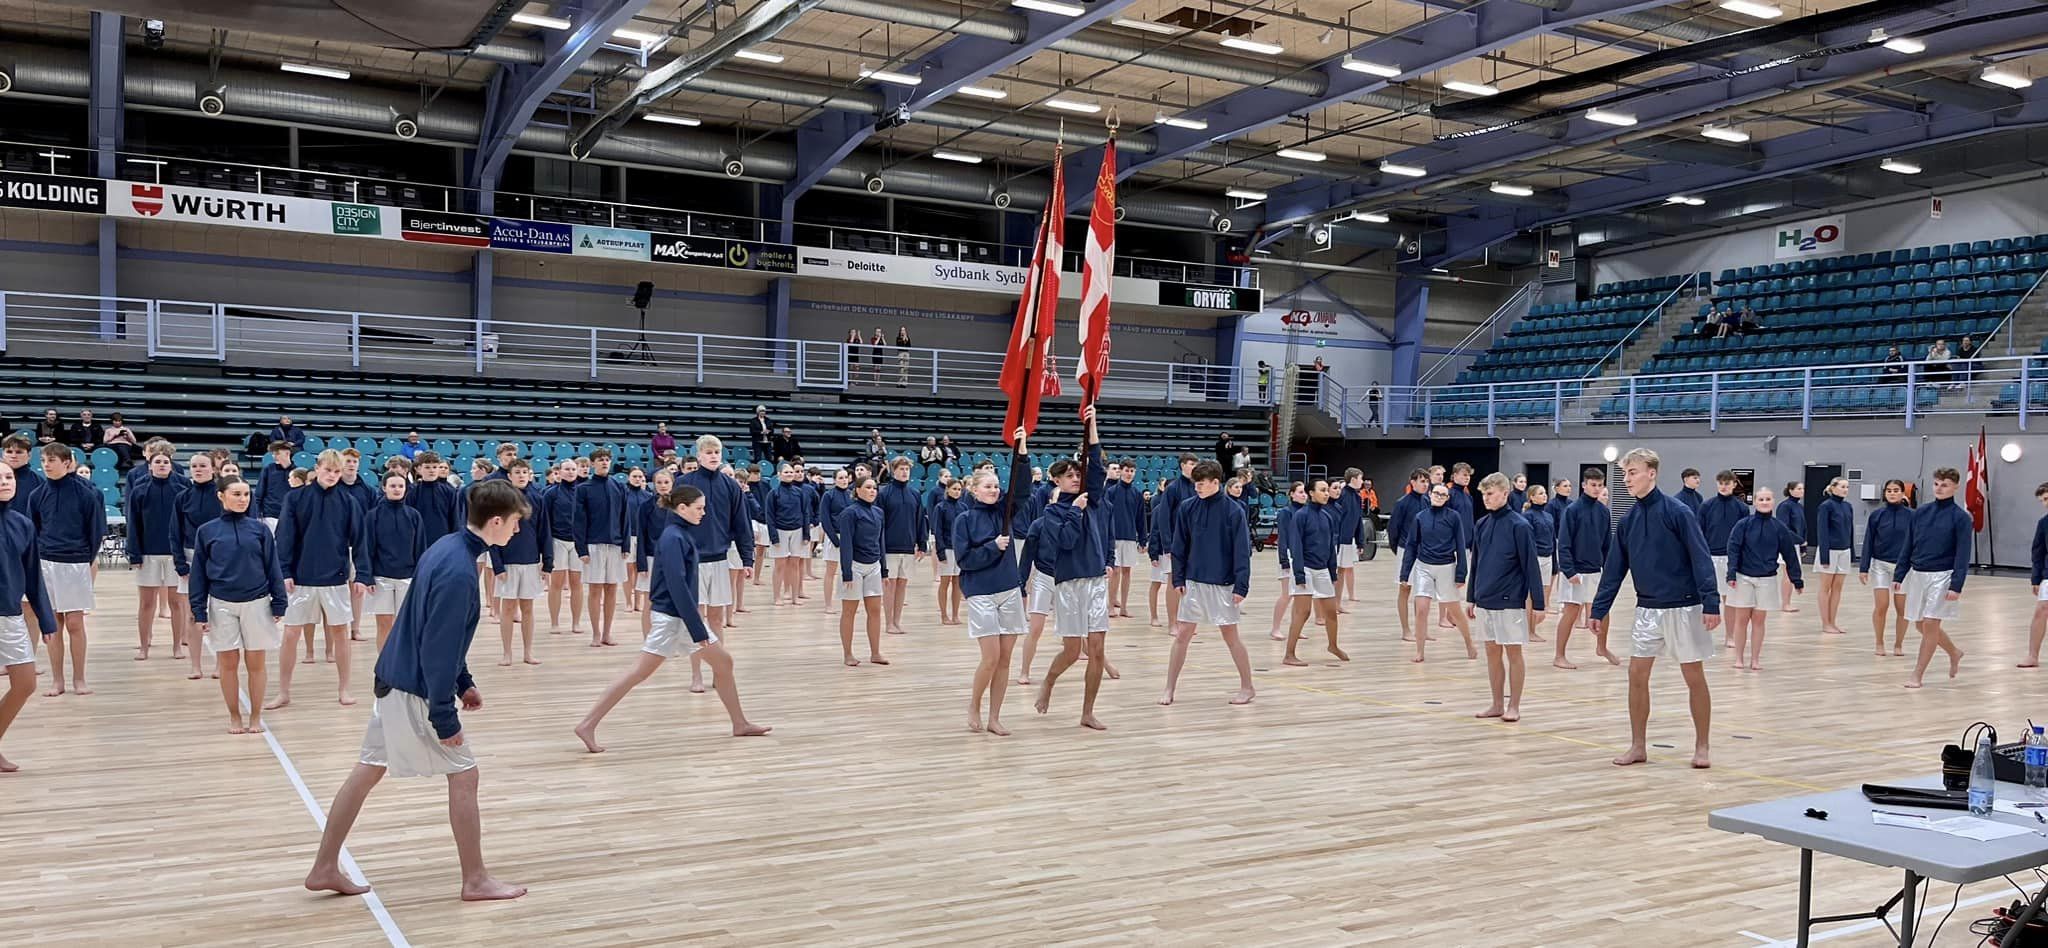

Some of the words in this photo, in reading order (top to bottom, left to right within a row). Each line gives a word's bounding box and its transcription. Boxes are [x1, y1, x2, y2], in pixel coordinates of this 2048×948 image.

[7, 181, 99, 205] KOLDING
[171, 193, 286, 224] WÜRTH
[336, 207, 376, 219] DESIGN
[336, 217, 360, 227] CITY
[410, 219, 482, 234] Bjertinvest
[493, 225, 553, 240] Accu-Dan
[555, 232, 570, 242] A/S
[1779, 225, 1839, 251] H2O
[654, 241, 690, 259] MAX
[935, 264, 990, 280] Sydbank
[995, 270, 1026, 285] Sydb
